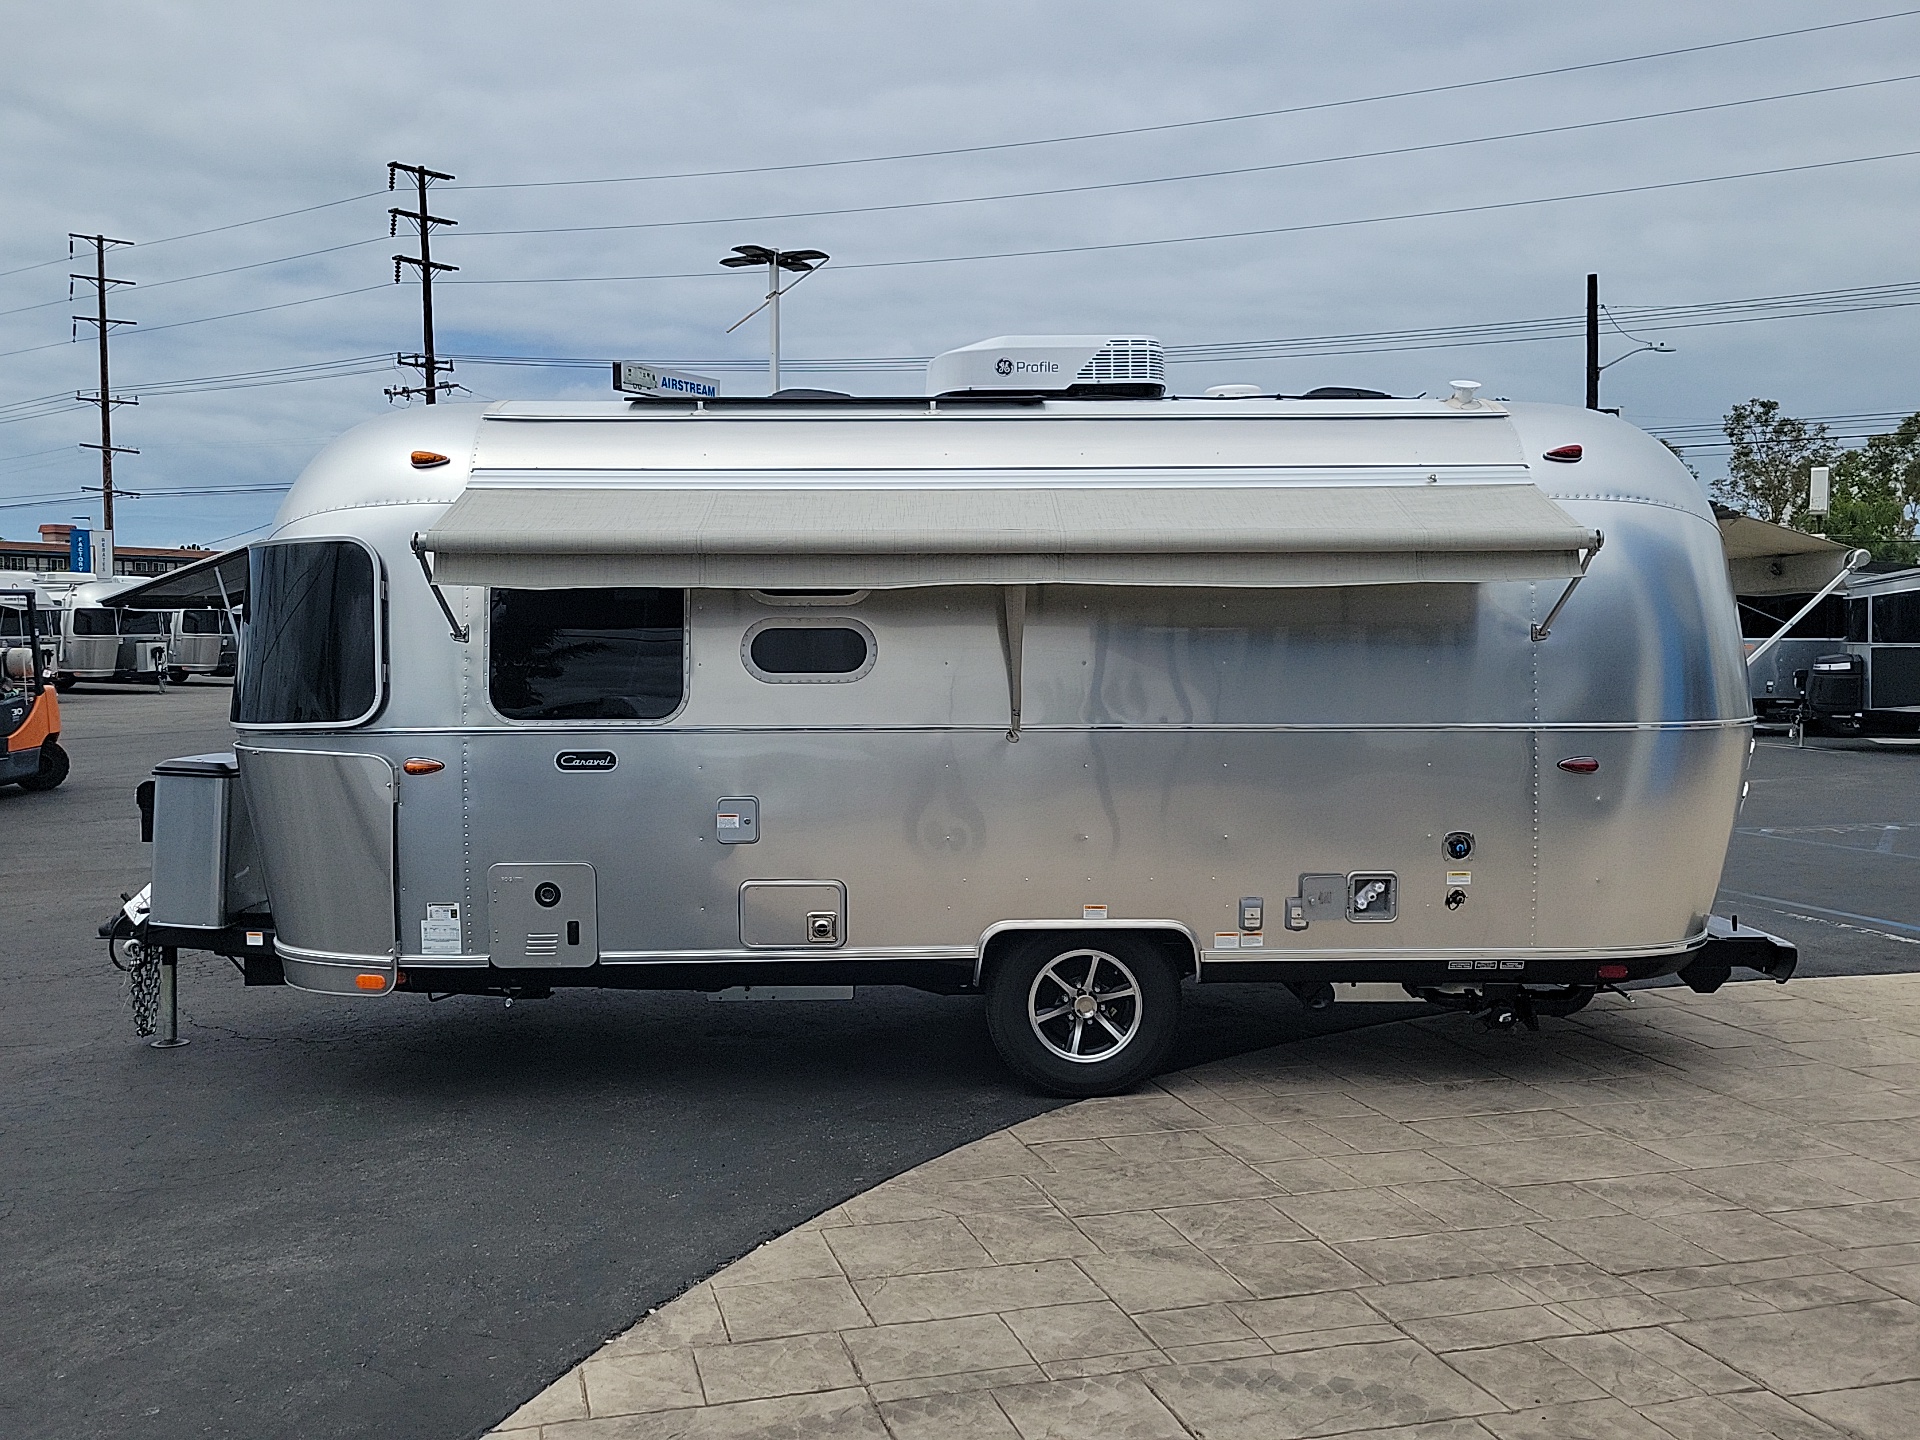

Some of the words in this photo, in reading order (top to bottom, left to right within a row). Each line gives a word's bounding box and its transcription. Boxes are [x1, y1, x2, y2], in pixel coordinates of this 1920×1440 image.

[1016, 361, 1059, 373] Profile
[661, 376, 716, 397] AIRSTREAM
[11, 708, 23, 716] 30
[561, 755, 614, 766] Caravel
